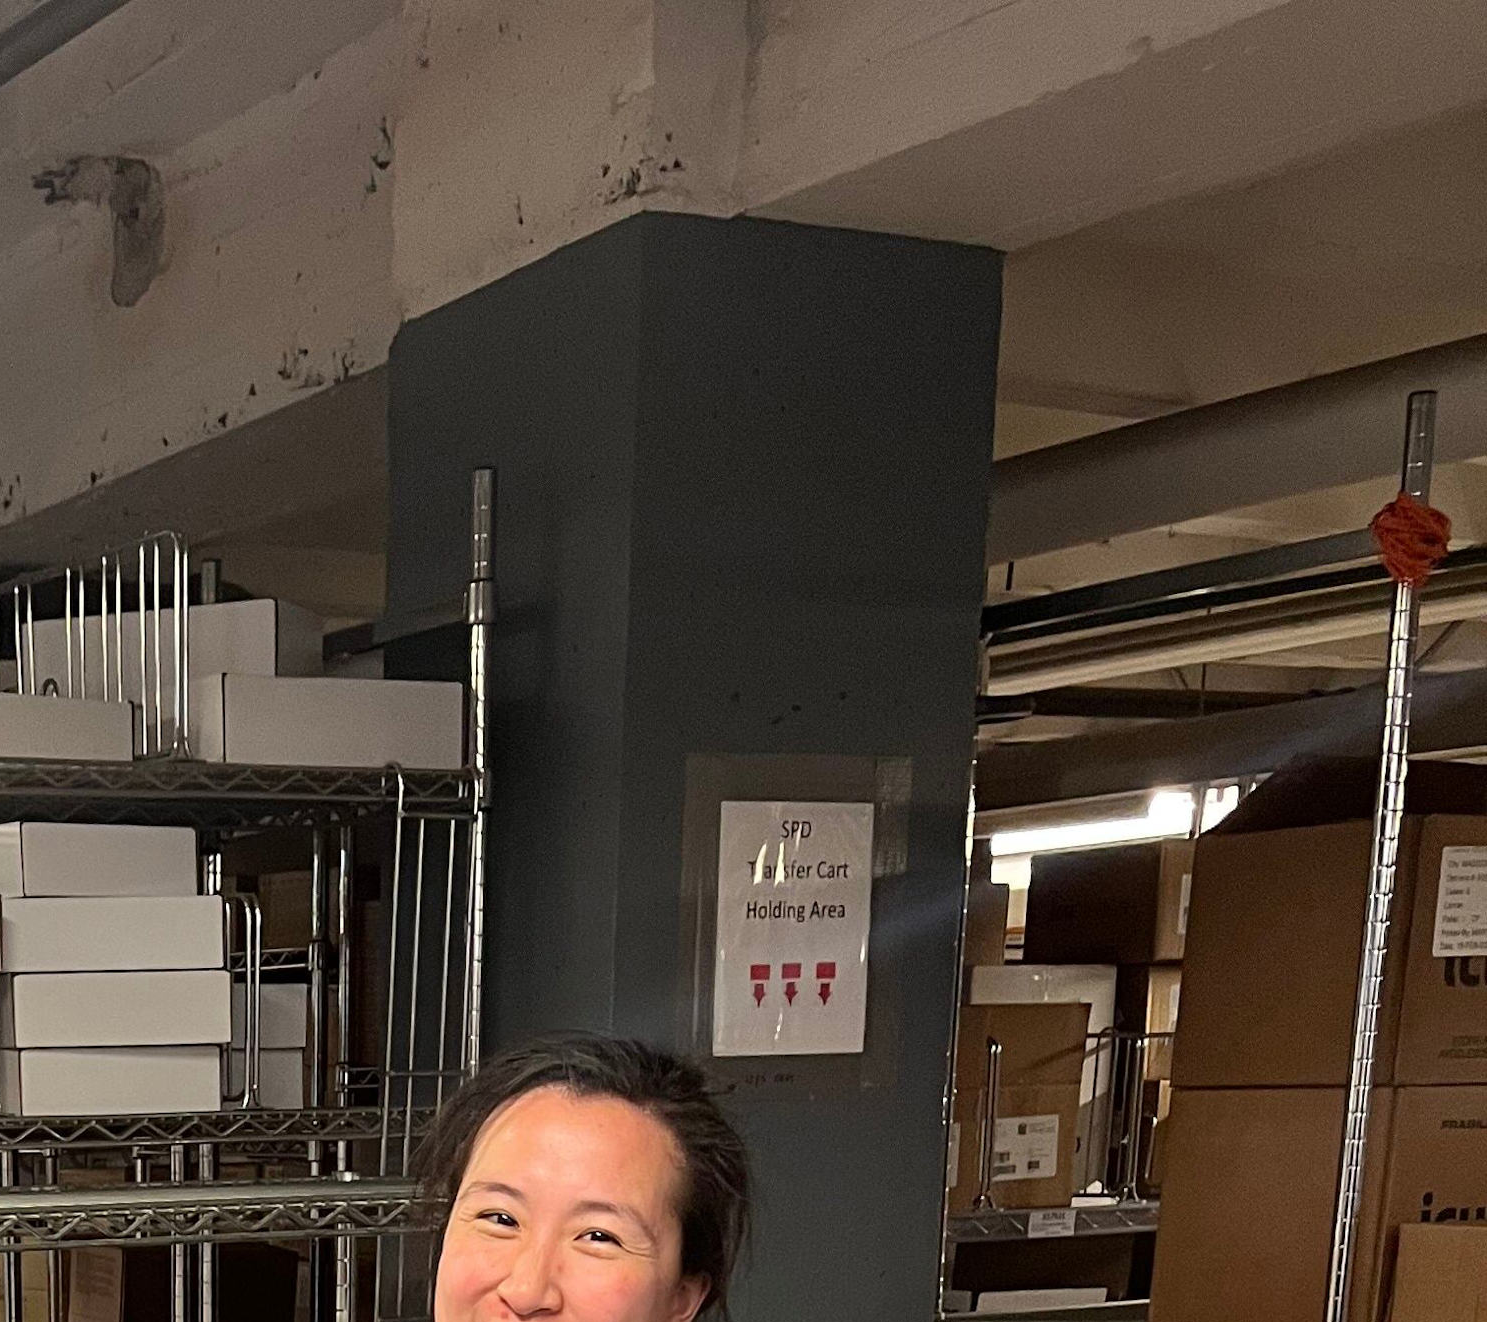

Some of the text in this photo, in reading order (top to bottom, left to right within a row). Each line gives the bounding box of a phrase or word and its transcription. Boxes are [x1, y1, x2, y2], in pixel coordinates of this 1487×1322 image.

[780, 820, 812, 839] SPD
[816, 861, 849, 879] Cart
[746, 900, 846, 923] Holding Area
